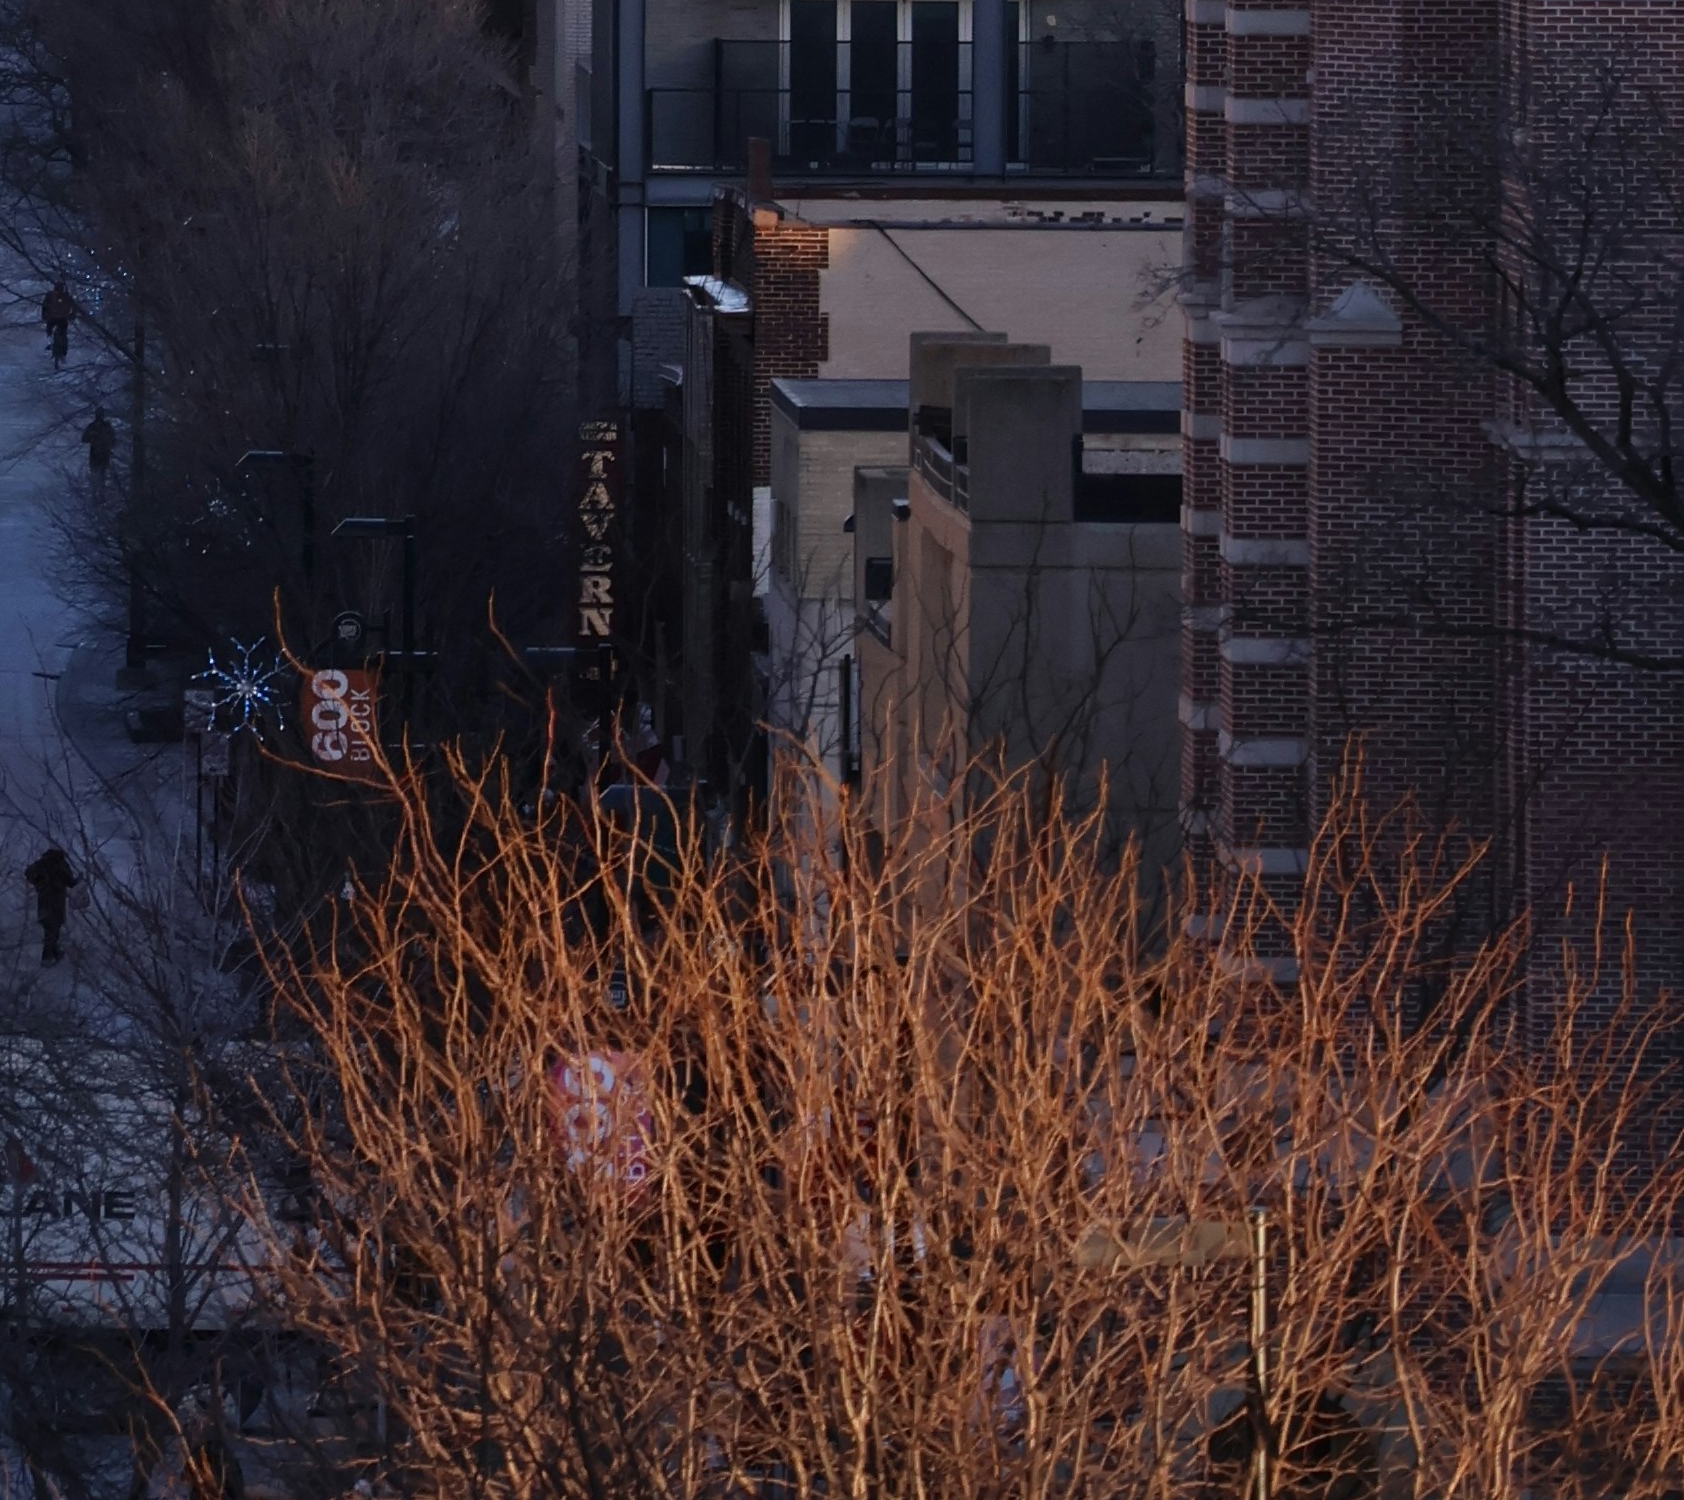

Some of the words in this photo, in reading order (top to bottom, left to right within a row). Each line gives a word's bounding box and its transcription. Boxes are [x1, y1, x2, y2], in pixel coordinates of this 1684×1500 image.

[578, 449, 616, 637] TAVERN
[312, 668, 349, 761] 600
[350, 688, 371, 762] BLOCK
